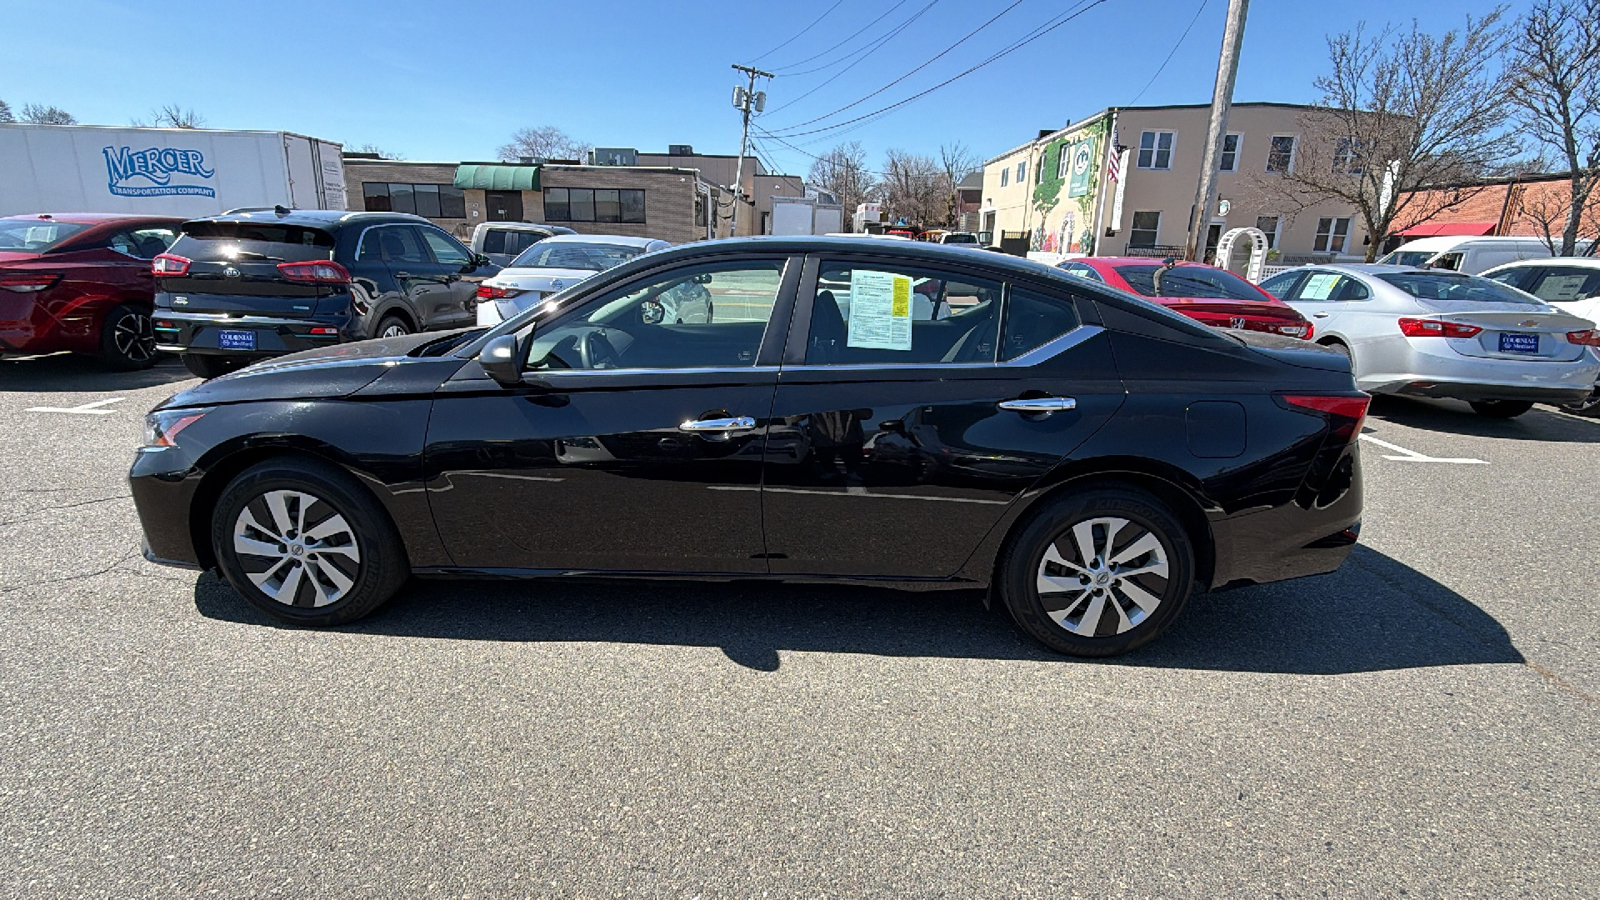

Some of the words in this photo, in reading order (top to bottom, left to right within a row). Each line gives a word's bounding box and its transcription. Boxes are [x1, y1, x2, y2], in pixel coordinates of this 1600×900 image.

[103, 146, 214, 185] MERCER
[113, 186, 177, 196] TRANSPORTATION
[178, 187, 214, 197] COMPANY
